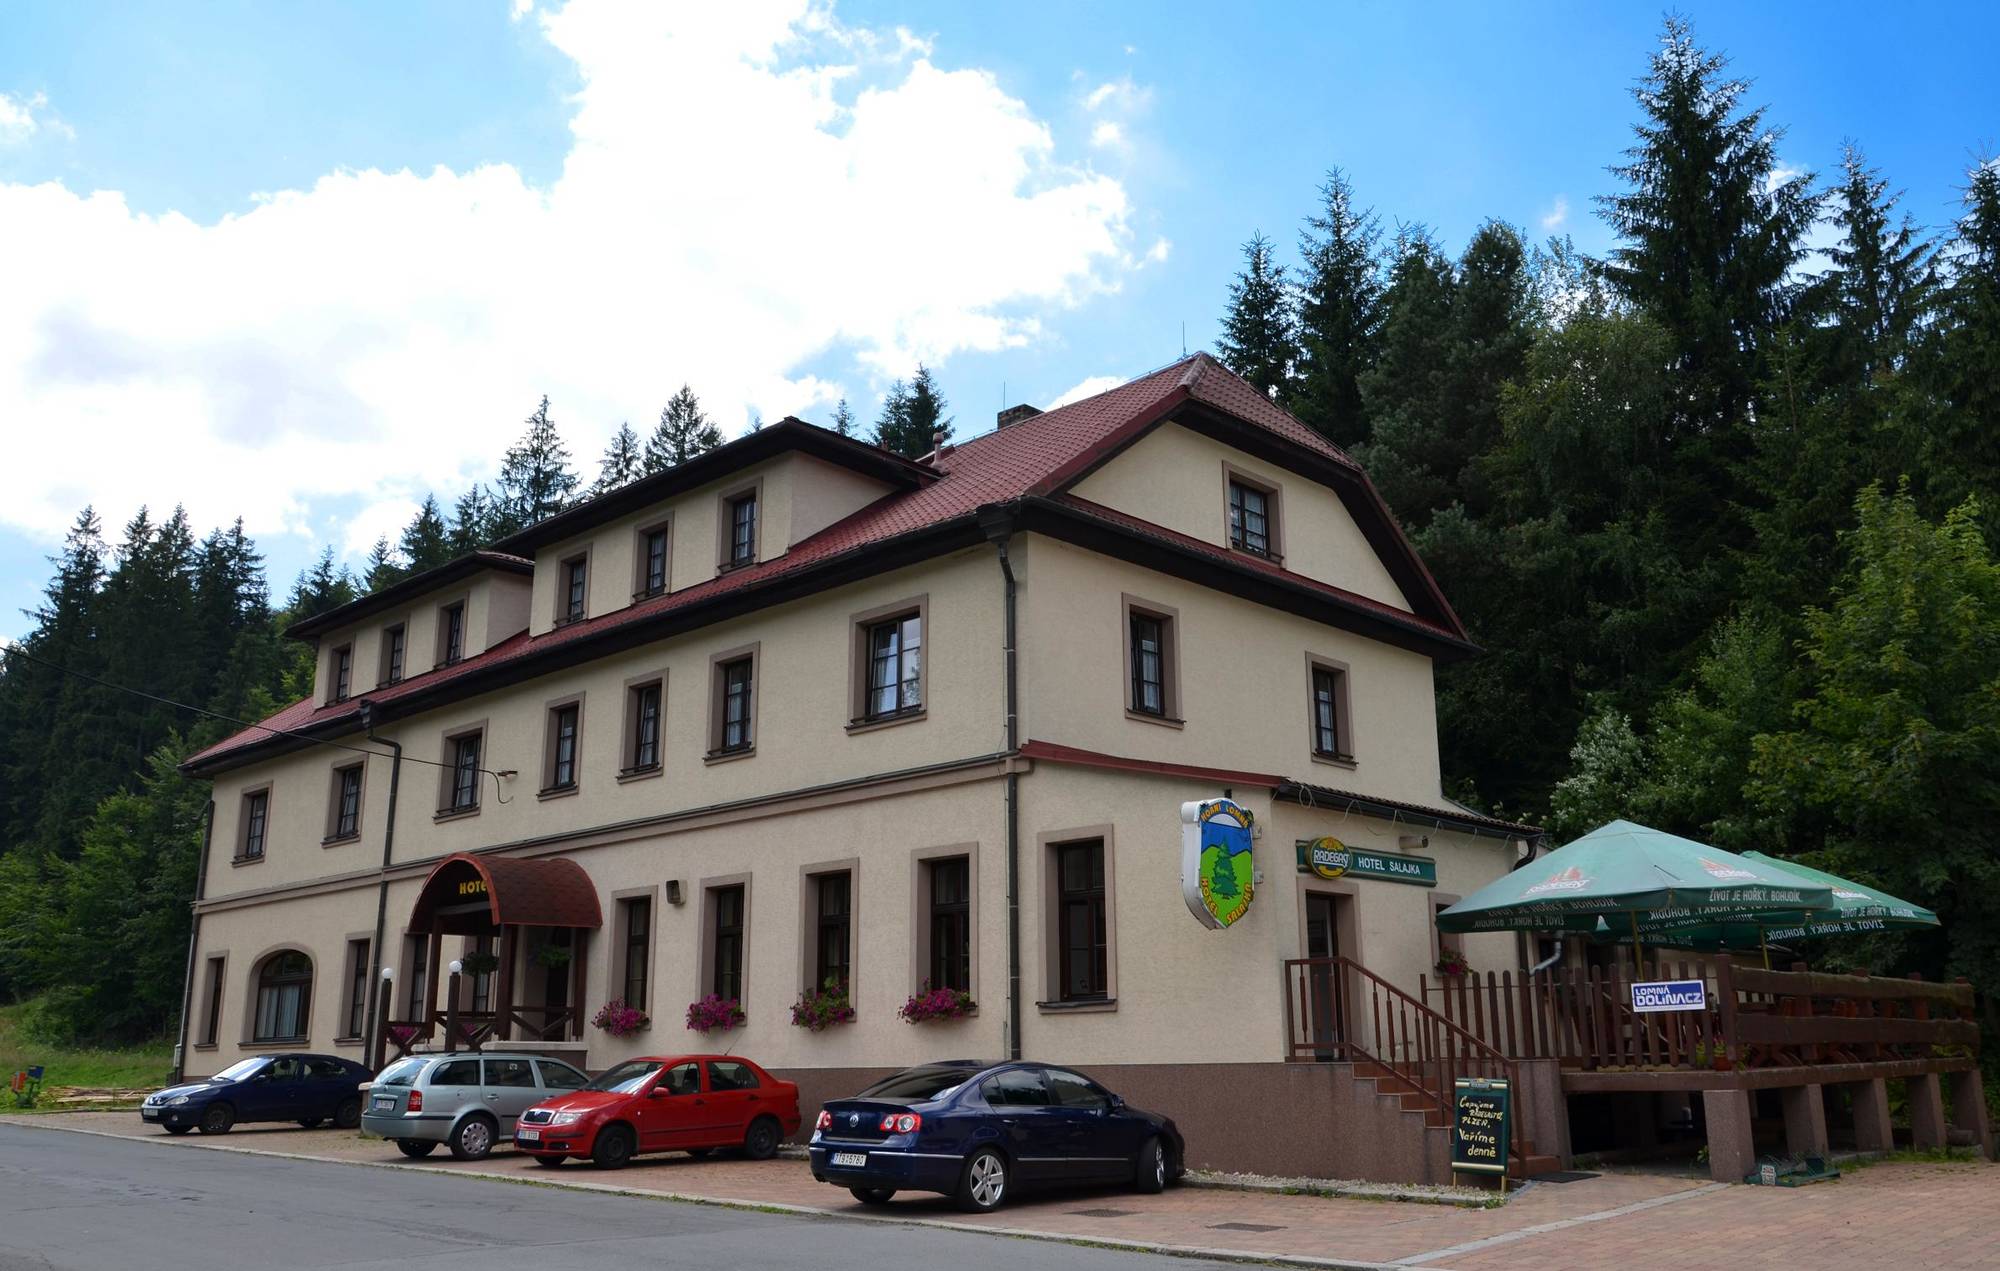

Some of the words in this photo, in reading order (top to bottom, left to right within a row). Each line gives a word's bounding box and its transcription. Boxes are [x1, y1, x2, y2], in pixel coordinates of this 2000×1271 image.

[1358, 857, 1386, 871] HOTEL
[1389, 861, 1421, 875] SALAJKA
[459, 880, 487, 895] HOTE
[1201, 876, 1218, 915] HOTEL
[1732, 890, 1741, 902] JE
[1635, 985, 1670, 996] LOMNÁ
